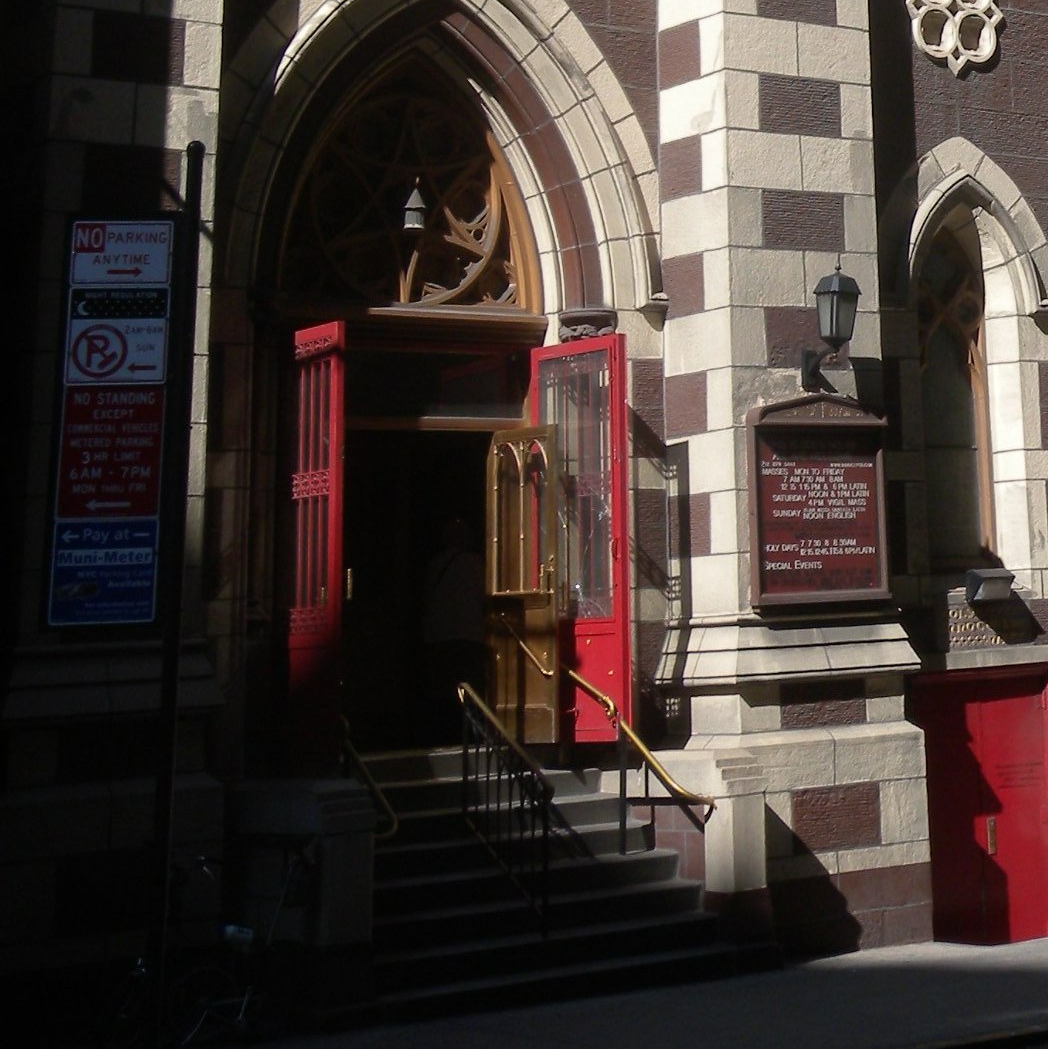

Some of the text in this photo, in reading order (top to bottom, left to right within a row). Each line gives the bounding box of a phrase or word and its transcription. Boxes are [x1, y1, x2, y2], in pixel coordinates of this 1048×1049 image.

[77, 227, 168, 249] NO PARKING
[93, 254, 151, 265] ANYTIME
[73, 392, 156, 405] NO STANDING
[92, 409, 135, 420] EXCEPT
[67, 422, 159, 433] COMMERCIAL VEHICLES
[70, 437, 154, 448] METERED PARKING
[81, 451, 141, 464] 3 HR LIMIT
[761, 468, 788, 476] MASSES
[72, 483, 146, 494] MON THRU FRI
[849, 483, 868, 491] LATIN
[772, 494, 807, 502] SATURDAY
[808, 490, 829, 498] NOON
[847, 498, 867, 506] MASS
[802, 511, 857, 520] NOON ENGLISH
[83, 528, 130, 544] Pay at
[781, 543, 799, 551] DAYS
[59, 551, 151, 563] Muni-Meter
[765, 561, 792, 570] SPECIAL
[77, 570, 97, 578] NYC
